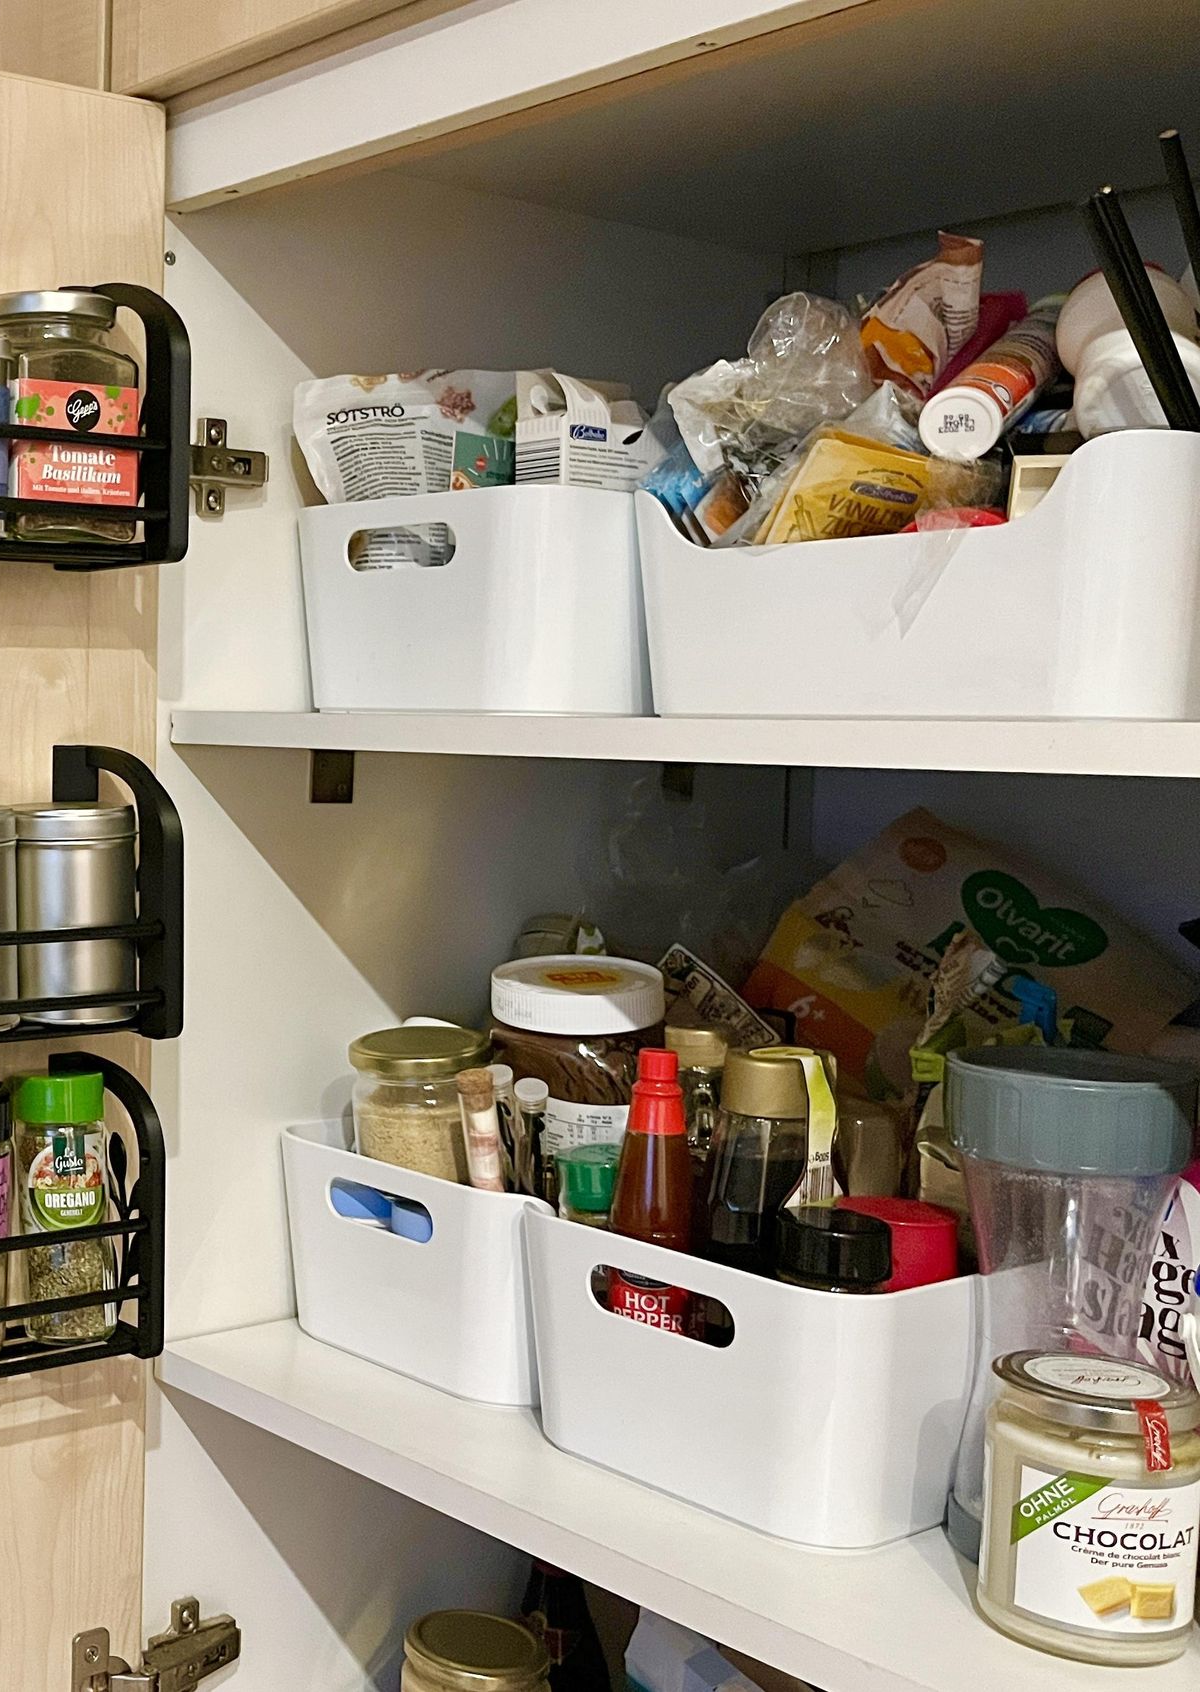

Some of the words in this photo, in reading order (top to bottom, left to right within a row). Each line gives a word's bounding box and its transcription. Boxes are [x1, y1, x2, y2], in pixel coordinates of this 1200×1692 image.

[49, 444, 116, 466] Tomate
[42, 464, 121, 484] Basilikum
[976, 887, 1076, 960] Olvarit
[55, 1156, 84, 1173] Gusto
[45, 1191, 96, 1208] OREGANO
[624, 1291, 670, 1313] HOT
[1019, 1477, 1075, 1518] OHNE
[1035, 1496, 1077, 1525] PALMÖL
[1053, 1521, 1194, 1550] CHOCOLAT
[1071, 1545, 1105, 1557] Crème
[1108, 1551, 1120, 1559] de
[1122, 1551, 1161, 1561] chocolat
[1163, 1551, 1181, 1559] blanc
[1091, 1557, 1109, 1566] Der
